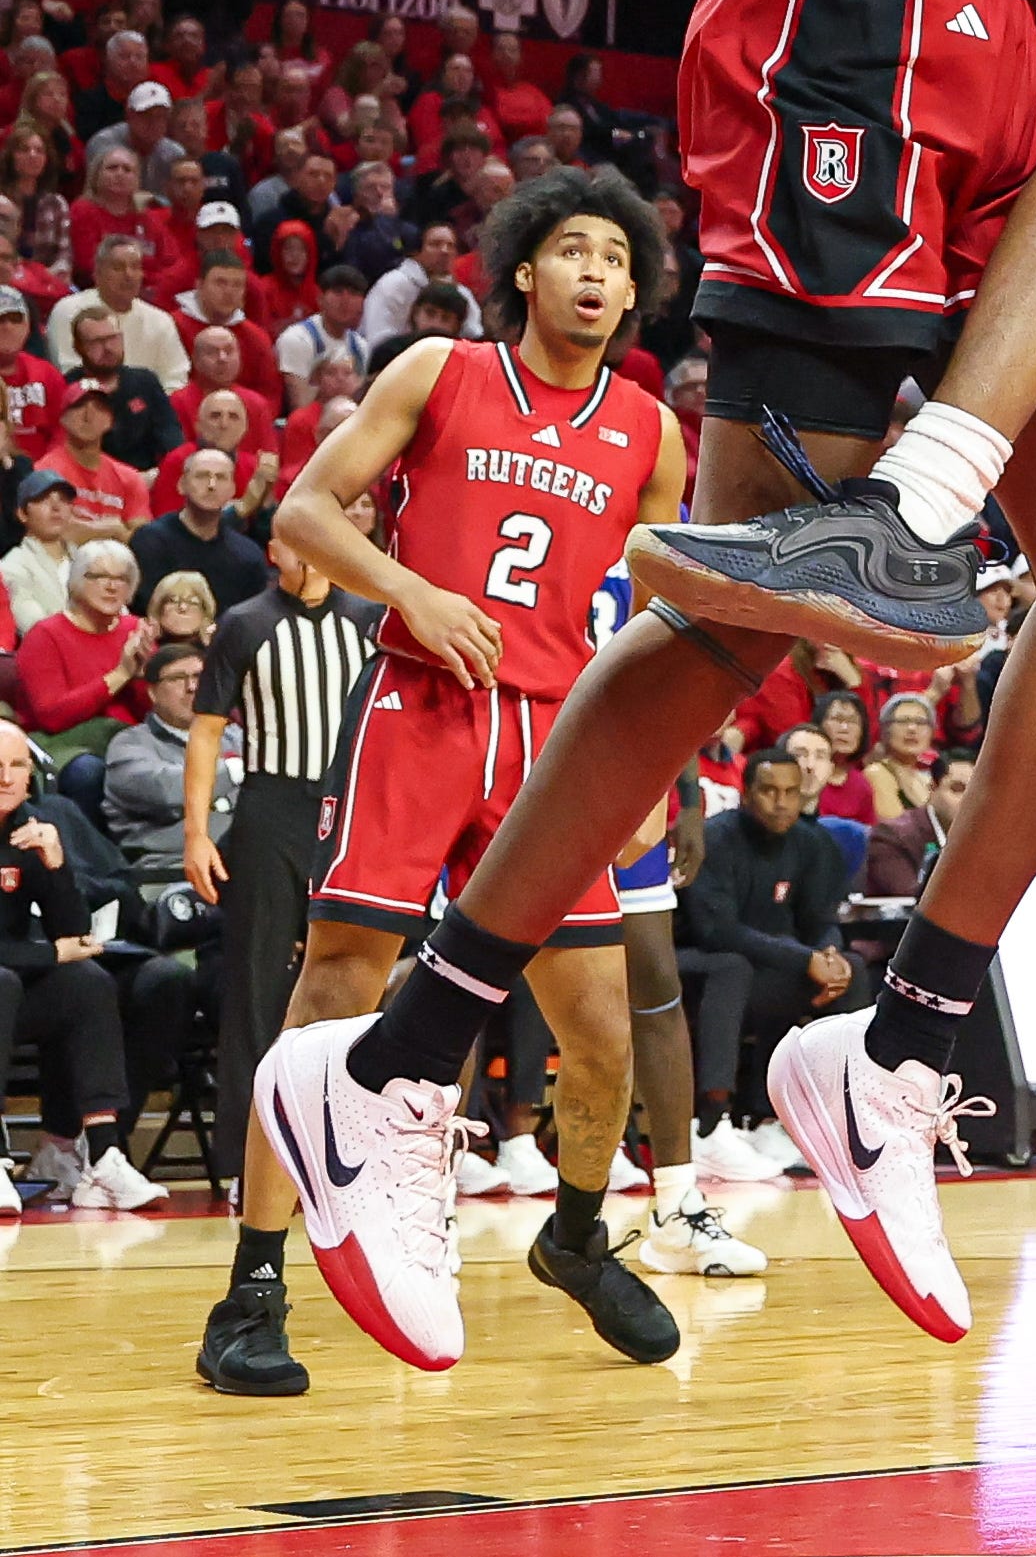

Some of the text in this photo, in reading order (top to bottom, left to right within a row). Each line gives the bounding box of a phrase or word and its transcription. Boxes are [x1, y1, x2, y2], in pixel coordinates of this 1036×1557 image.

[812, 138, 853, 189] R
[466, 448, 613, 515] RUTGERS
[485, 510, 553, 610] 2
